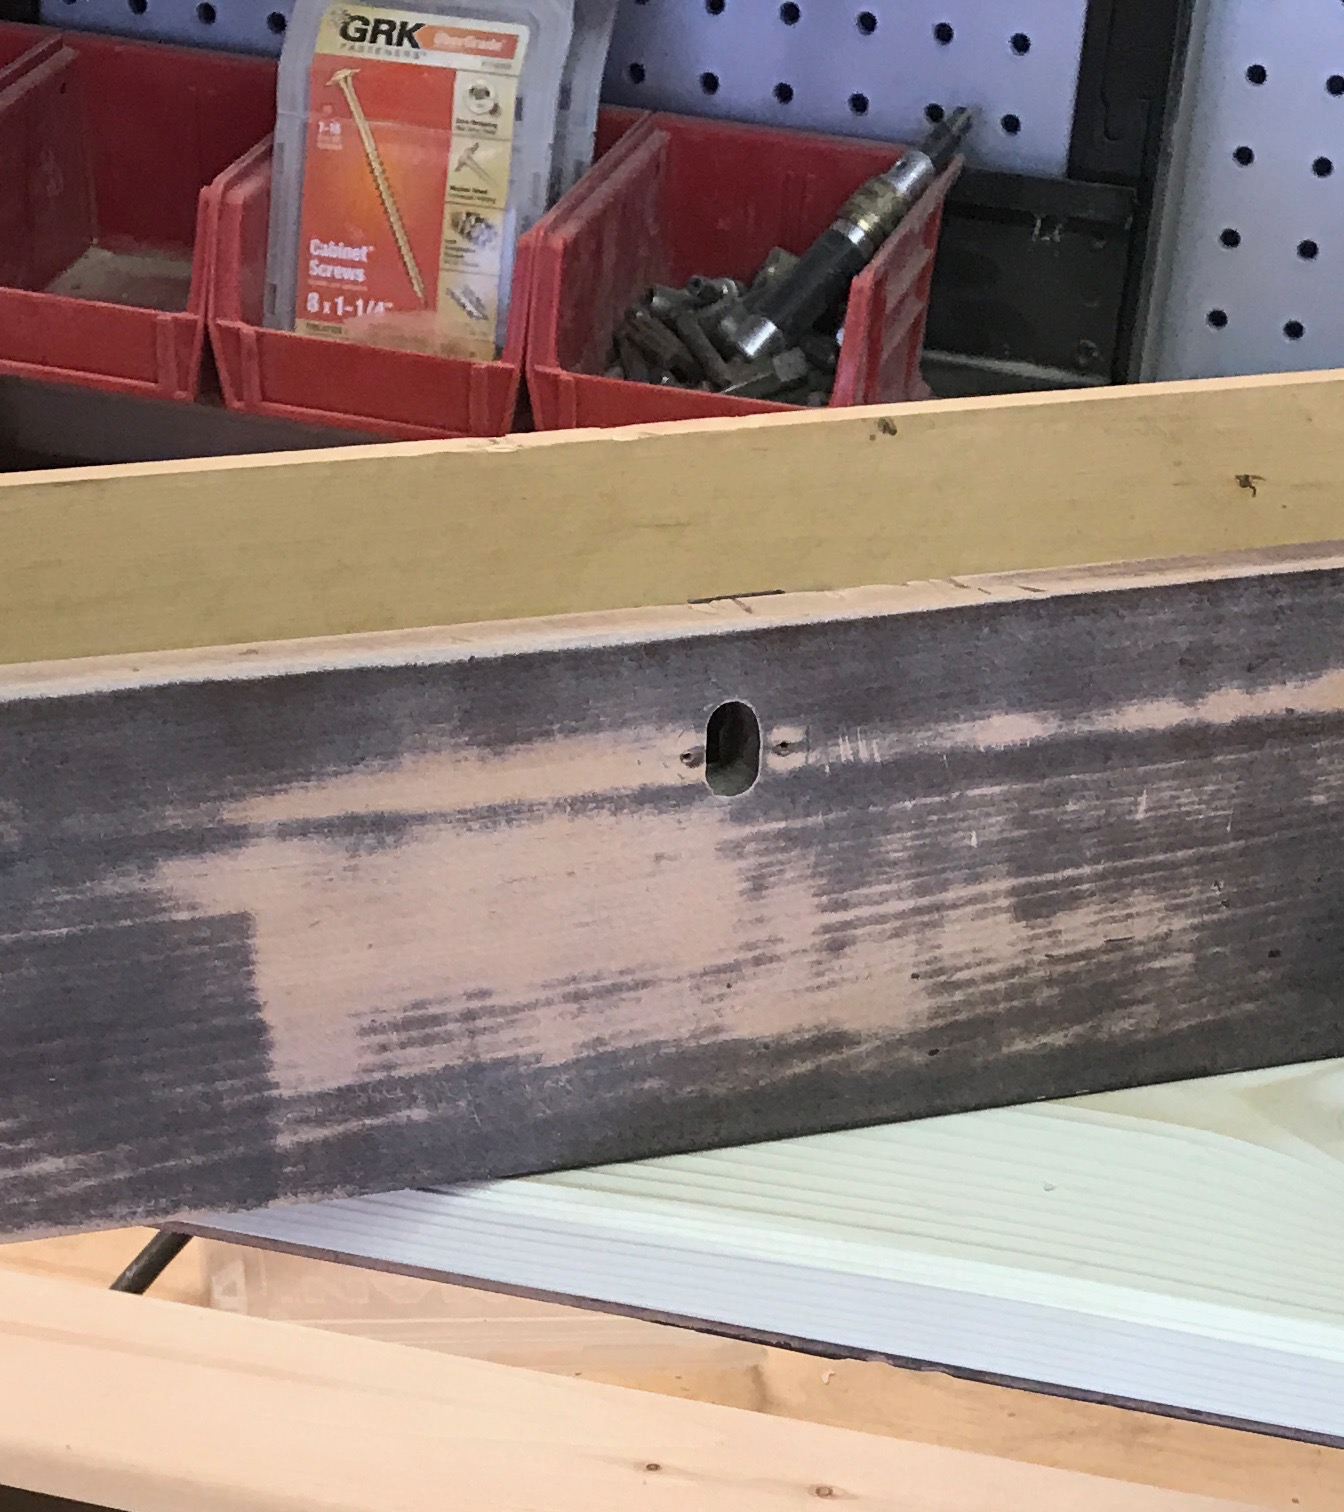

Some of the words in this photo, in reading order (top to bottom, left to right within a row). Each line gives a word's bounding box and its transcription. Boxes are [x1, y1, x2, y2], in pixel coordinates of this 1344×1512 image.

[339, 14, 426, 50] GRK
[309, 259, 366, 283] Screws
[307, 292, 320, 314] 8
[323, 300, 332, 315] x
